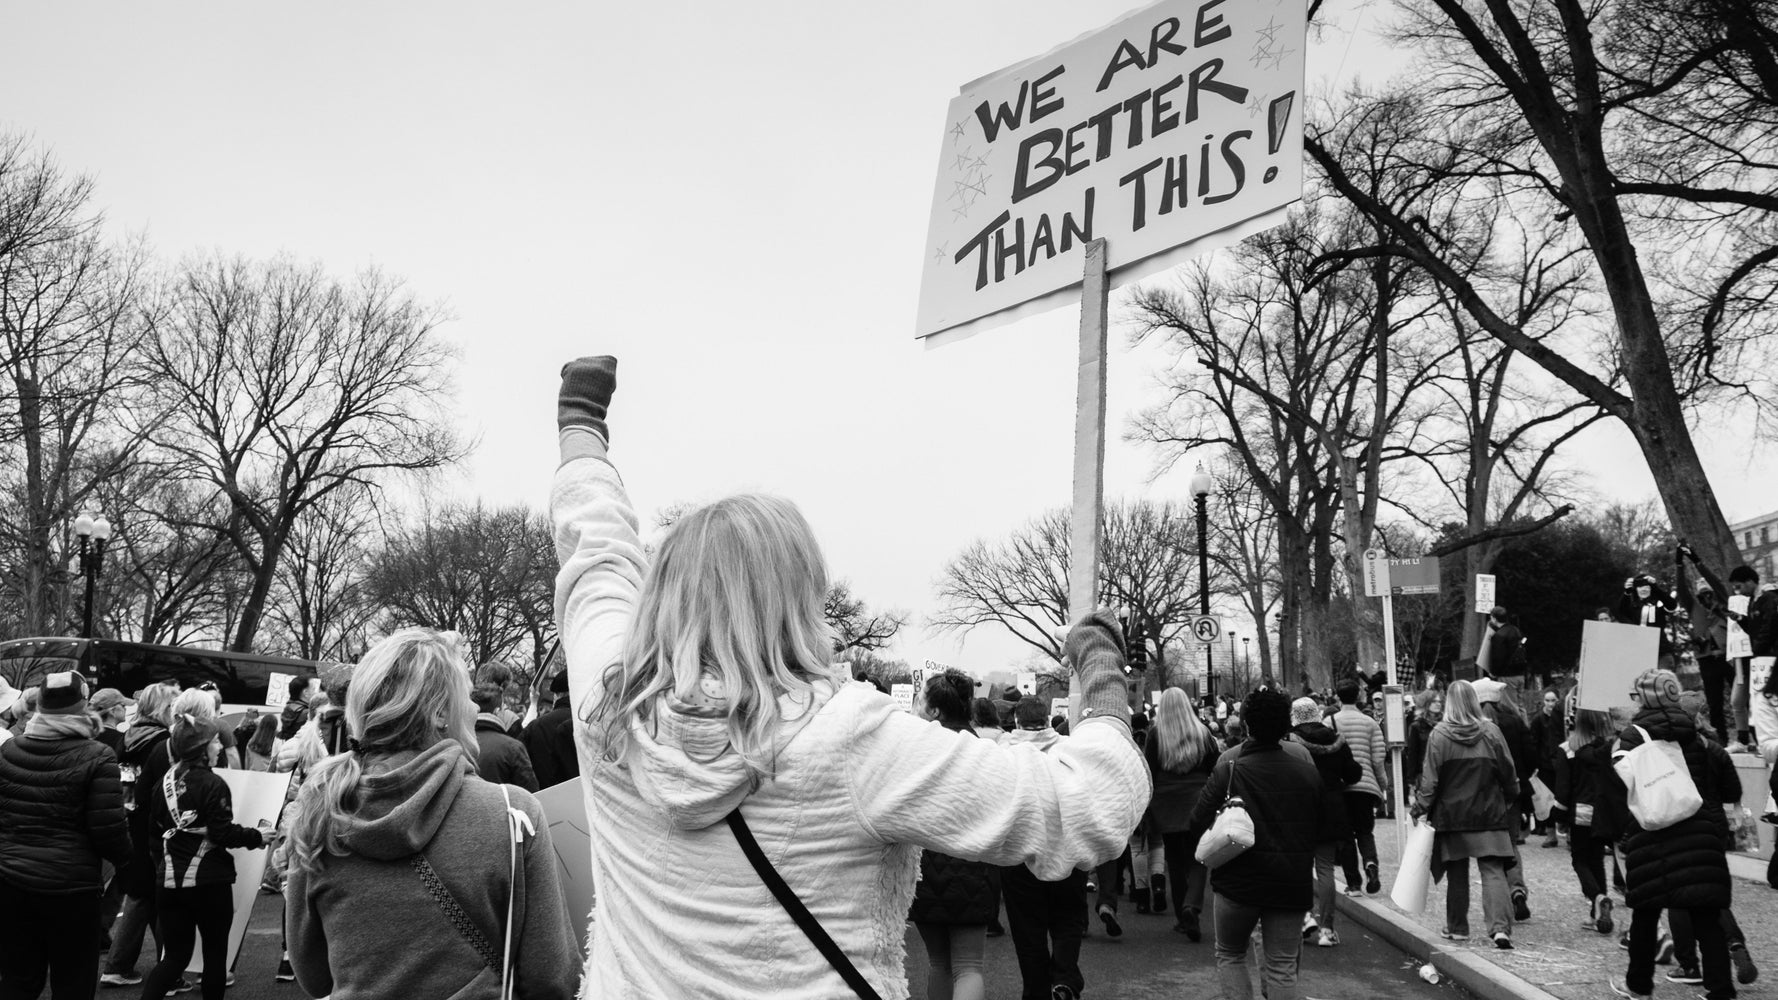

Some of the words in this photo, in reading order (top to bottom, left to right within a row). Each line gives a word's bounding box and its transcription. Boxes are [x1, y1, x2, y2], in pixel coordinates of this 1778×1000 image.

[974, 64, 1066, 143] WE
[1096, 0, 1232, 92] ARE
[1011, 57, 1249, 204] BETTER
[955, 187, 1095, 292] THAN
